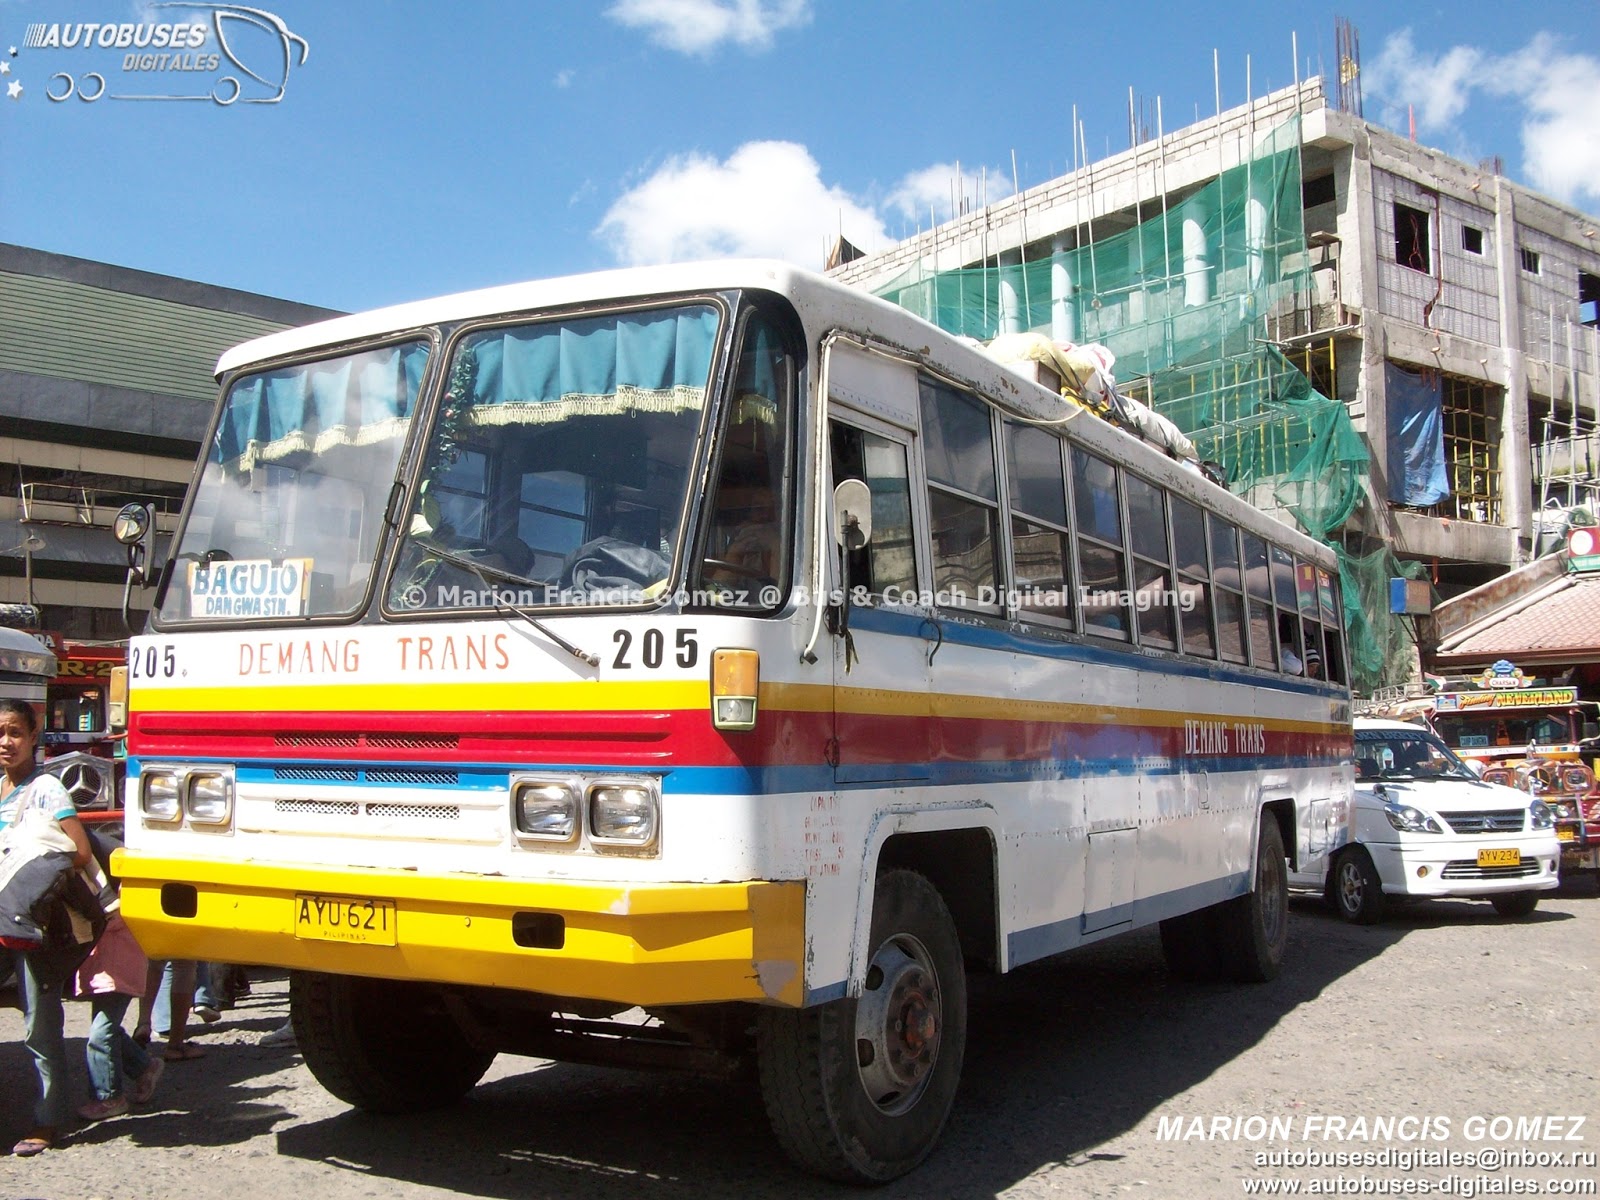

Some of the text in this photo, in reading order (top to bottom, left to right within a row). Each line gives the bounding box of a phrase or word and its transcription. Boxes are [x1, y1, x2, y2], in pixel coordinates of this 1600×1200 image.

[193, 563, 298, 596] BAGUIO
[132, 645, 176, 678] 205
[238, 633, 509, 676] DEMANG TRANS
[612, 629, 698, 669] 205
[1495, 690, 1574, 707] NEVERLAND
[1184, 719, 1266, 755] DEMANG TRANS
[323, 931, 367, 940] PILIPINAS
